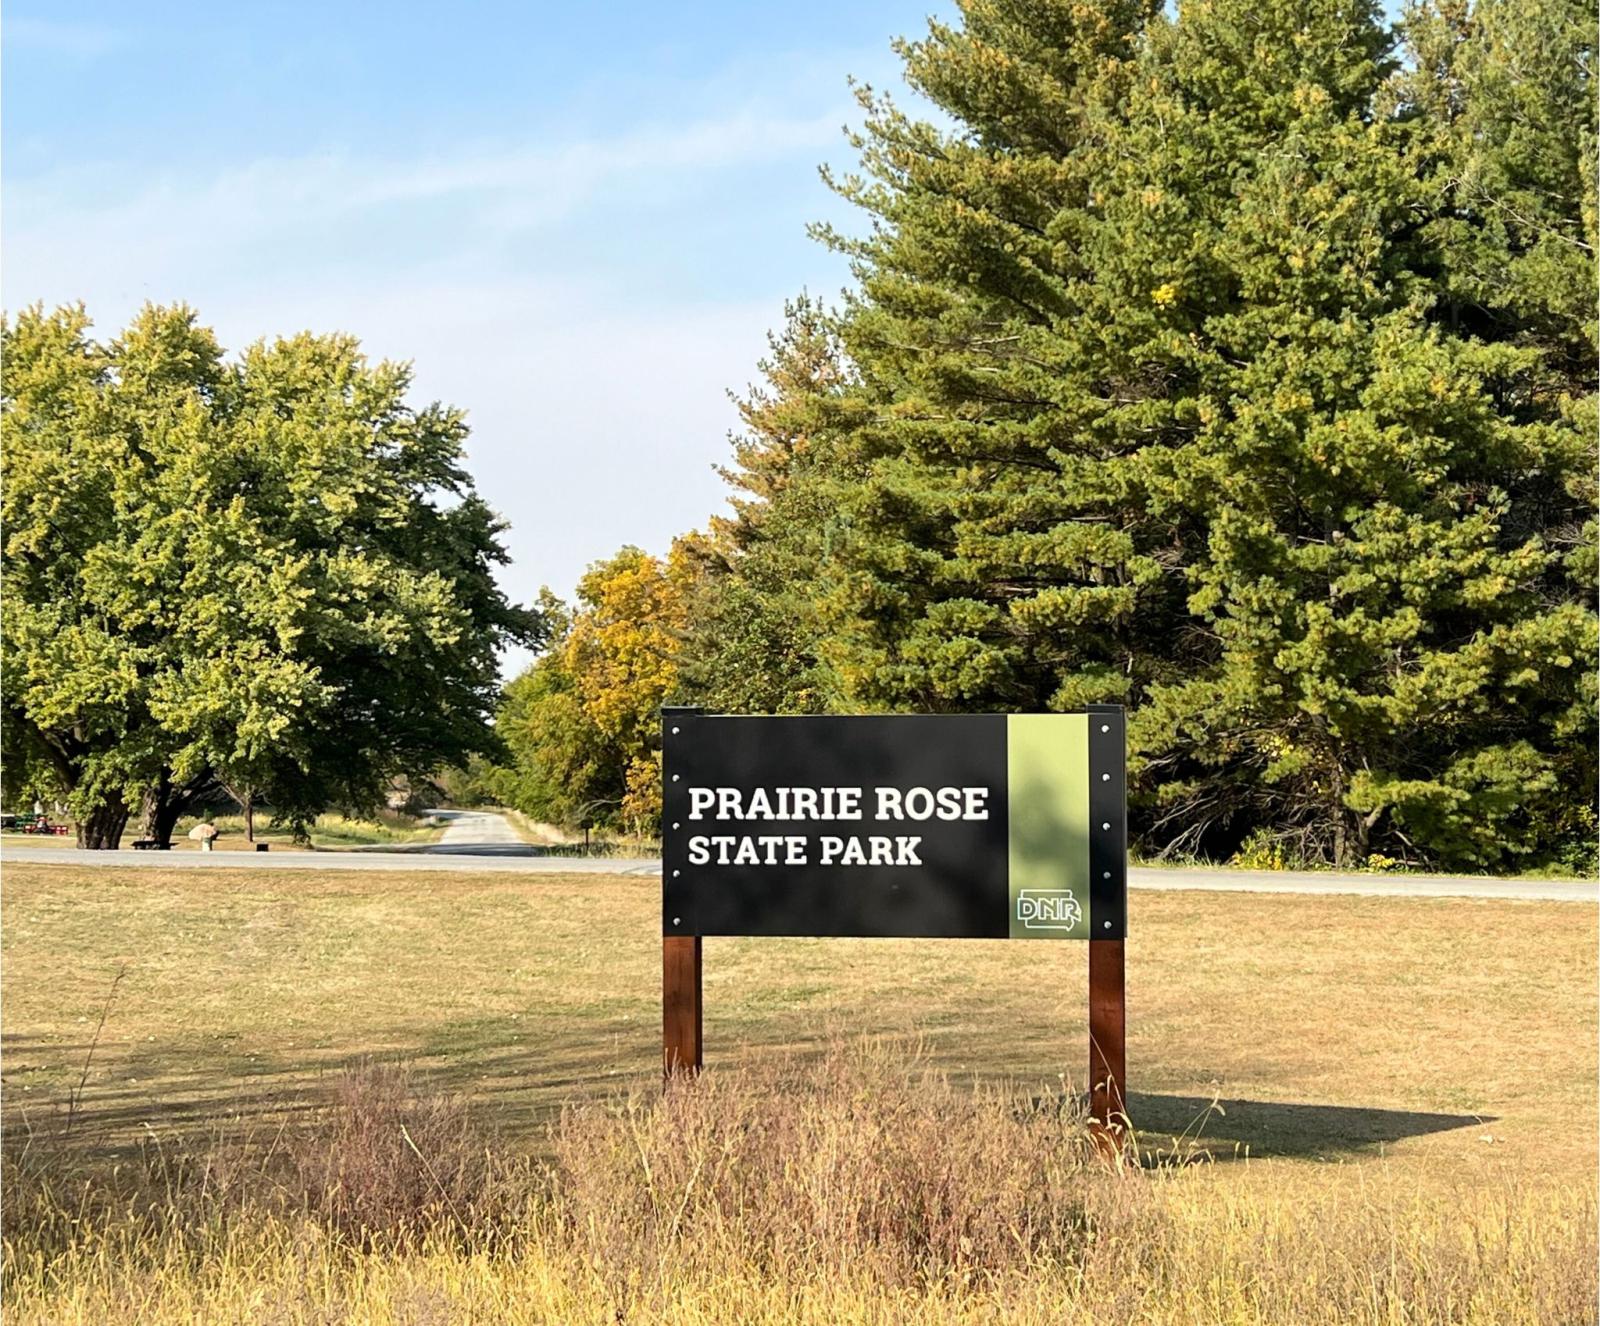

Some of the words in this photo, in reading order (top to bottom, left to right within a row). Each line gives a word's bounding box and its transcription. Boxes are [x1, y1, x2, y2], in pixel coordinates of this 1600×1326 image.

[688, 787, 863, 821] PRAIRIE
[874, 786, 989, 821] ROSE
[688, 835, 808, 865] STATE
[819, 836, 923, 866] PARK
[1017, 897, 1082, 922] DNR
